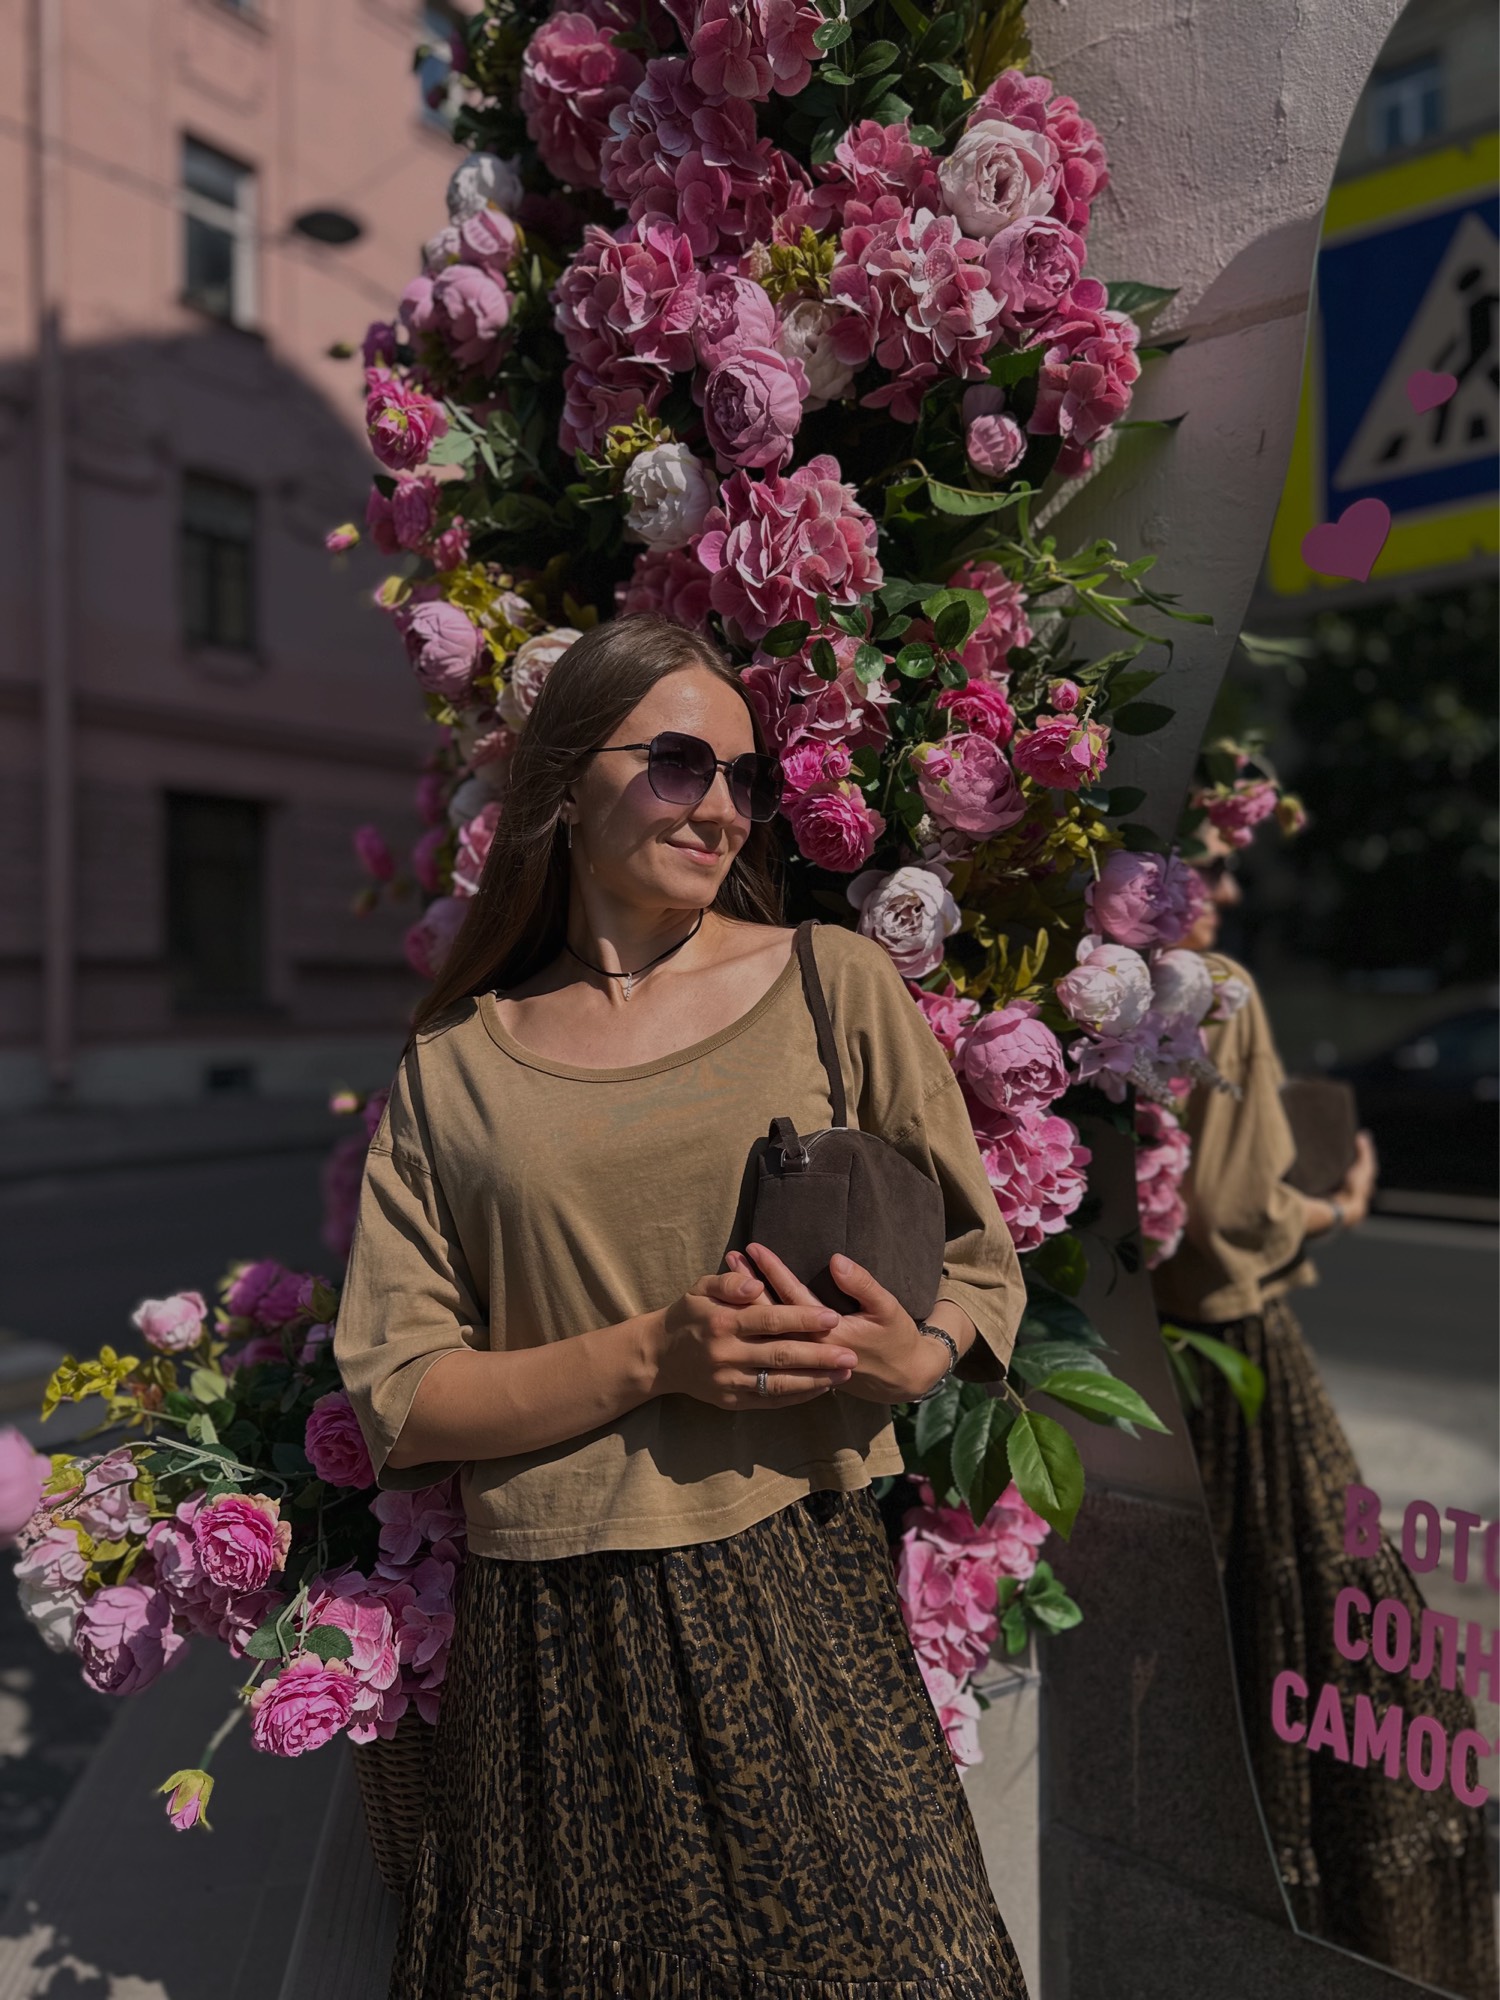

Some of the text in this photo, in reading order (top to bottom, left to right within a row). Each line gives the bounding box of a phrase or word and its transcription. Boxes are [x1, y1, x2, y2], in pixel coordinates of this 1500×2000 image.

[1343, 1483, 1381, 1558] В
[1333, 1586, 1500, 1704] СОЛН
[1271, 1670, 1500, 1807] САМОС
